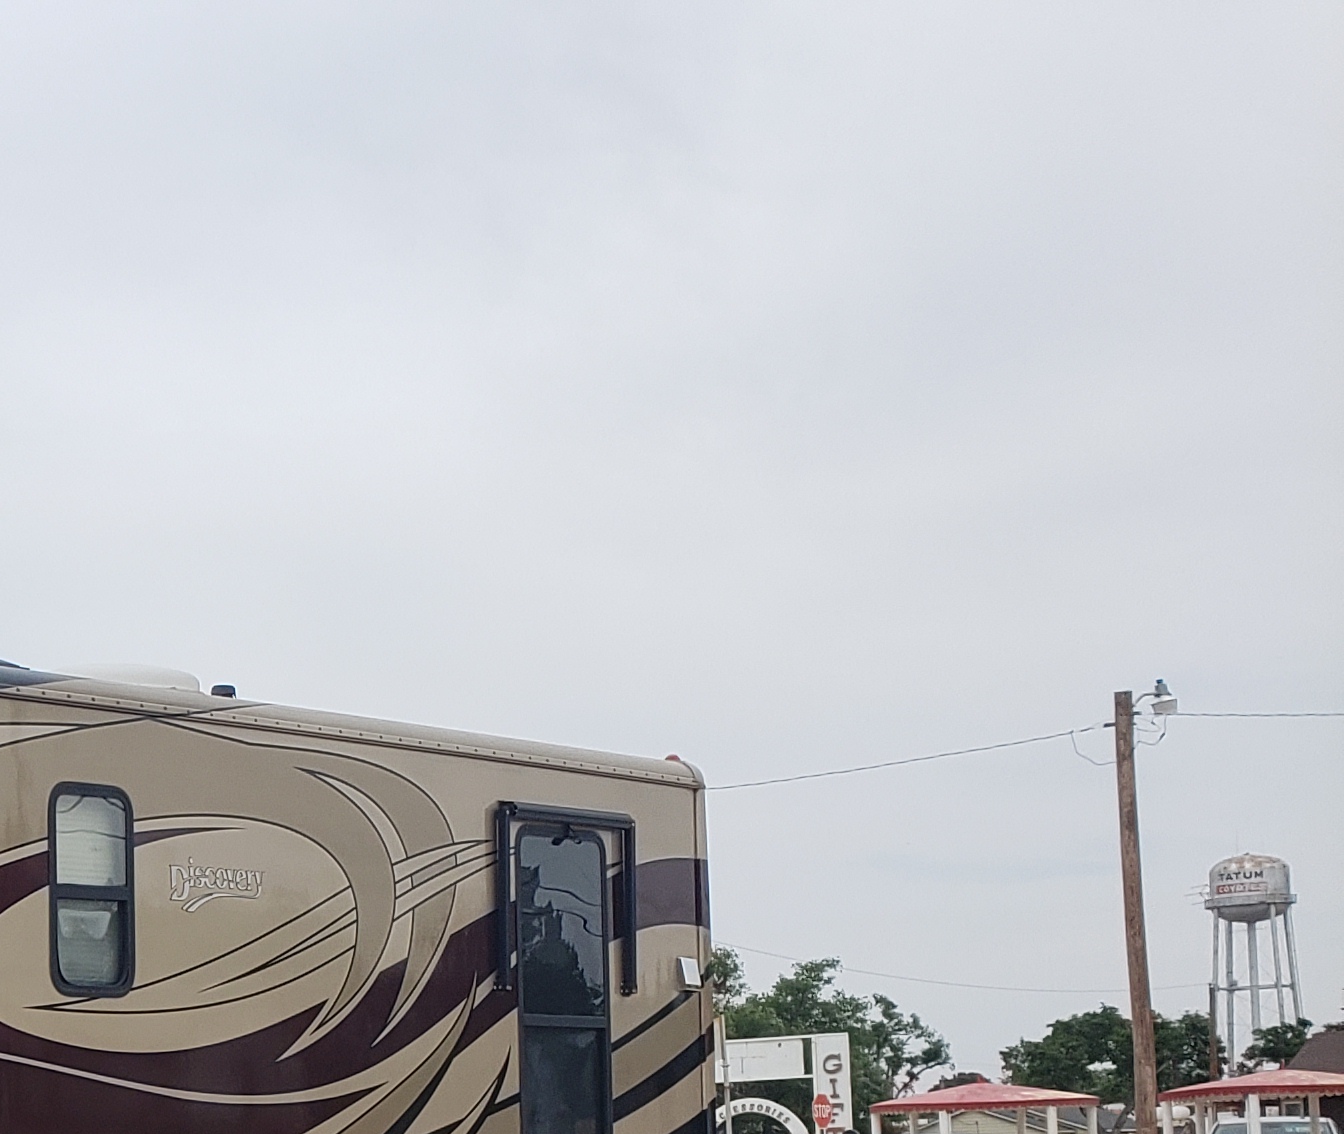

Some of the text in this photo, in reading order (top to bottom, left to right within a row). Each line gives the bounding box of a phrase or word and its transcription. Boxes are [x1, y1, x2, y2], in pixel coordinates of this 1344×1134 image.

[169, 856, 265, 902] Discovery
[1218, 870, 1264, 881] TATUM
[813, 1104, 832, 1118] STOP
